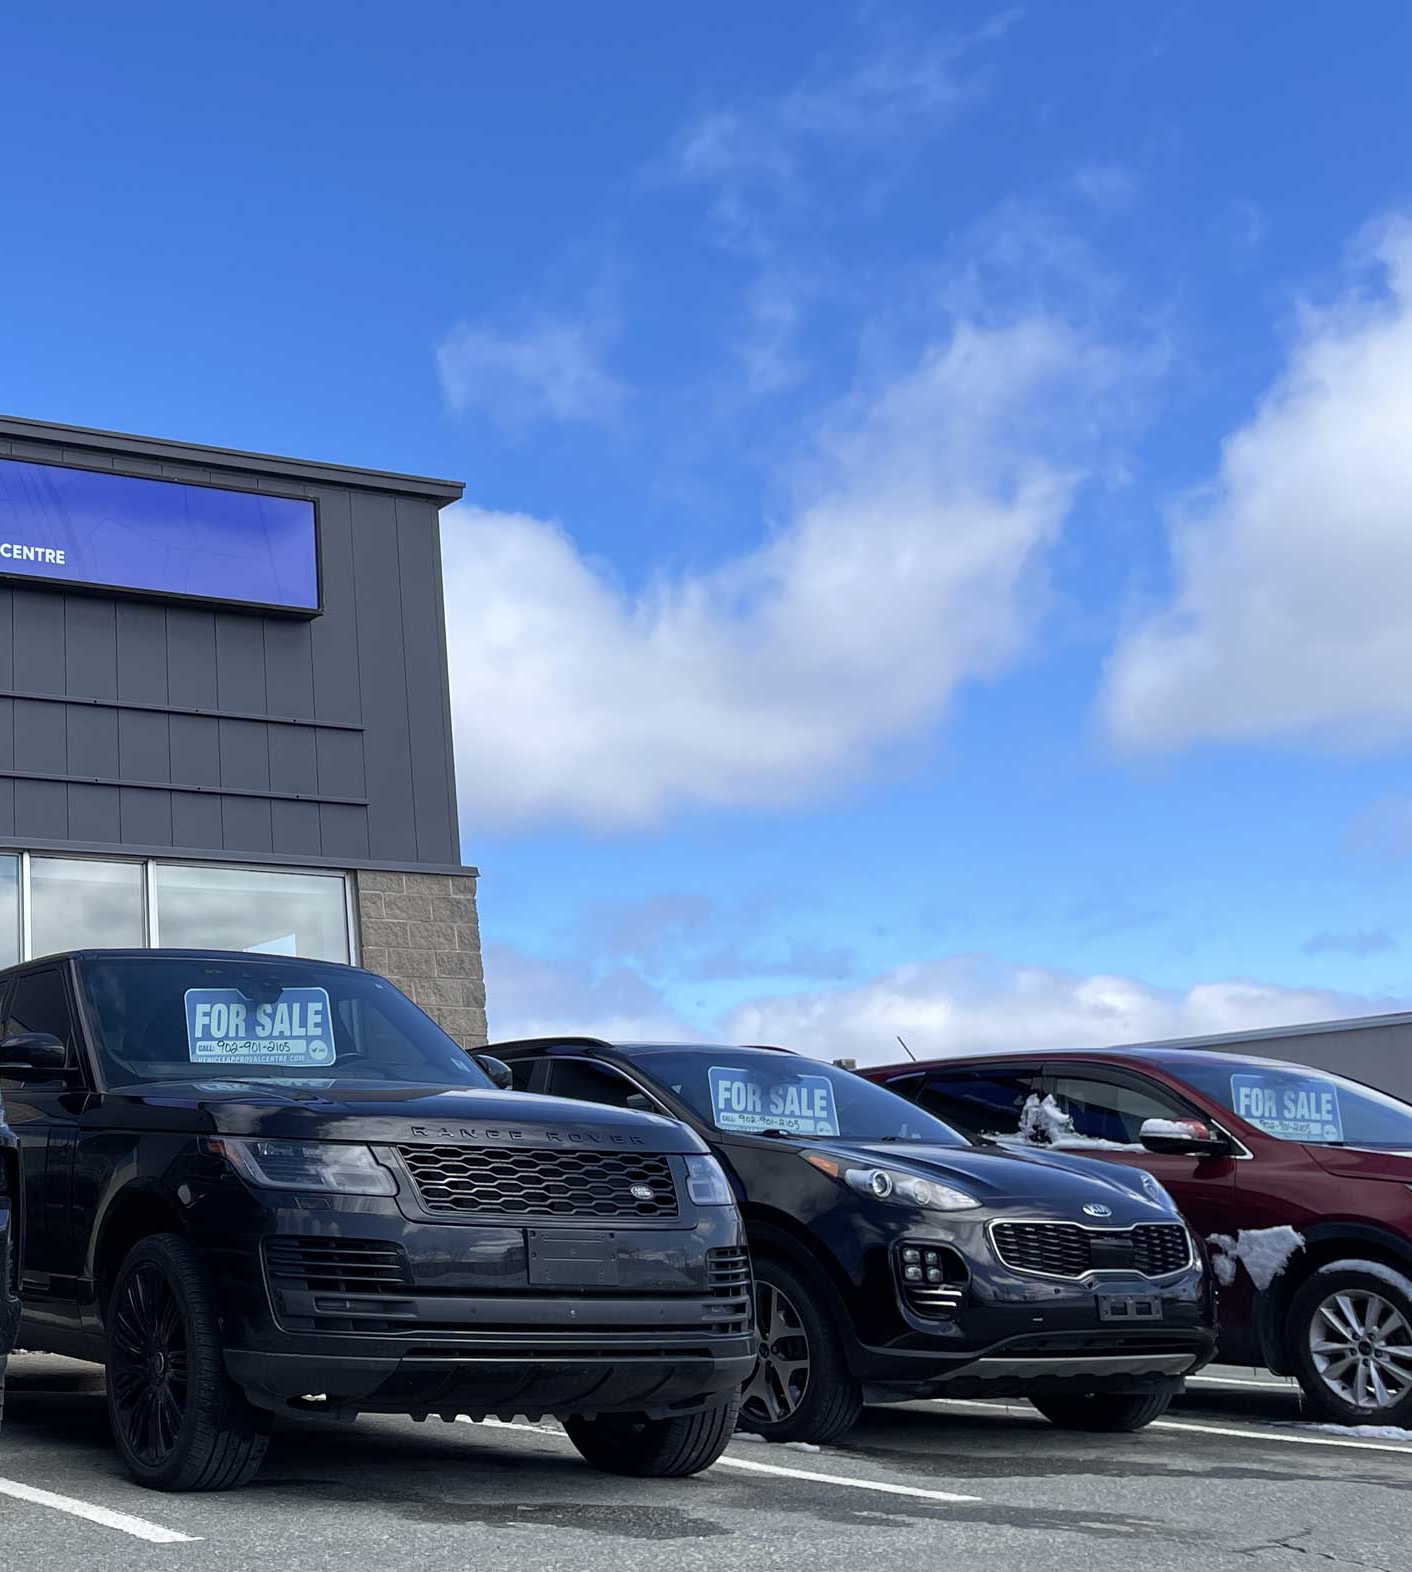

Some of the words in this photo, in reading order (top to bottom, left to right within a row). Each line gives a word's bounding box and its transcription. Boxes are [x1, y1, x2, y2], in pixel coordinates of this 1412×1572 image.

[0, 542, 66, 565] CENTRE
[194, 1003, 247, 1038] FOR
[255, 1002, 323, 1038] SALE
[217, 1040, 291, 1054] 902-901-2105
[718, 1080, 762, 1113] FOR
[770, 1086, 828, 1118] SALE
[1239, 1087, 1277, 1117] FOR
[1283, 1090, 1333, 1120] SALE
[411, 1126, 525, 1141] RANGE
[546, 1132, 645, 1145] ROVER
